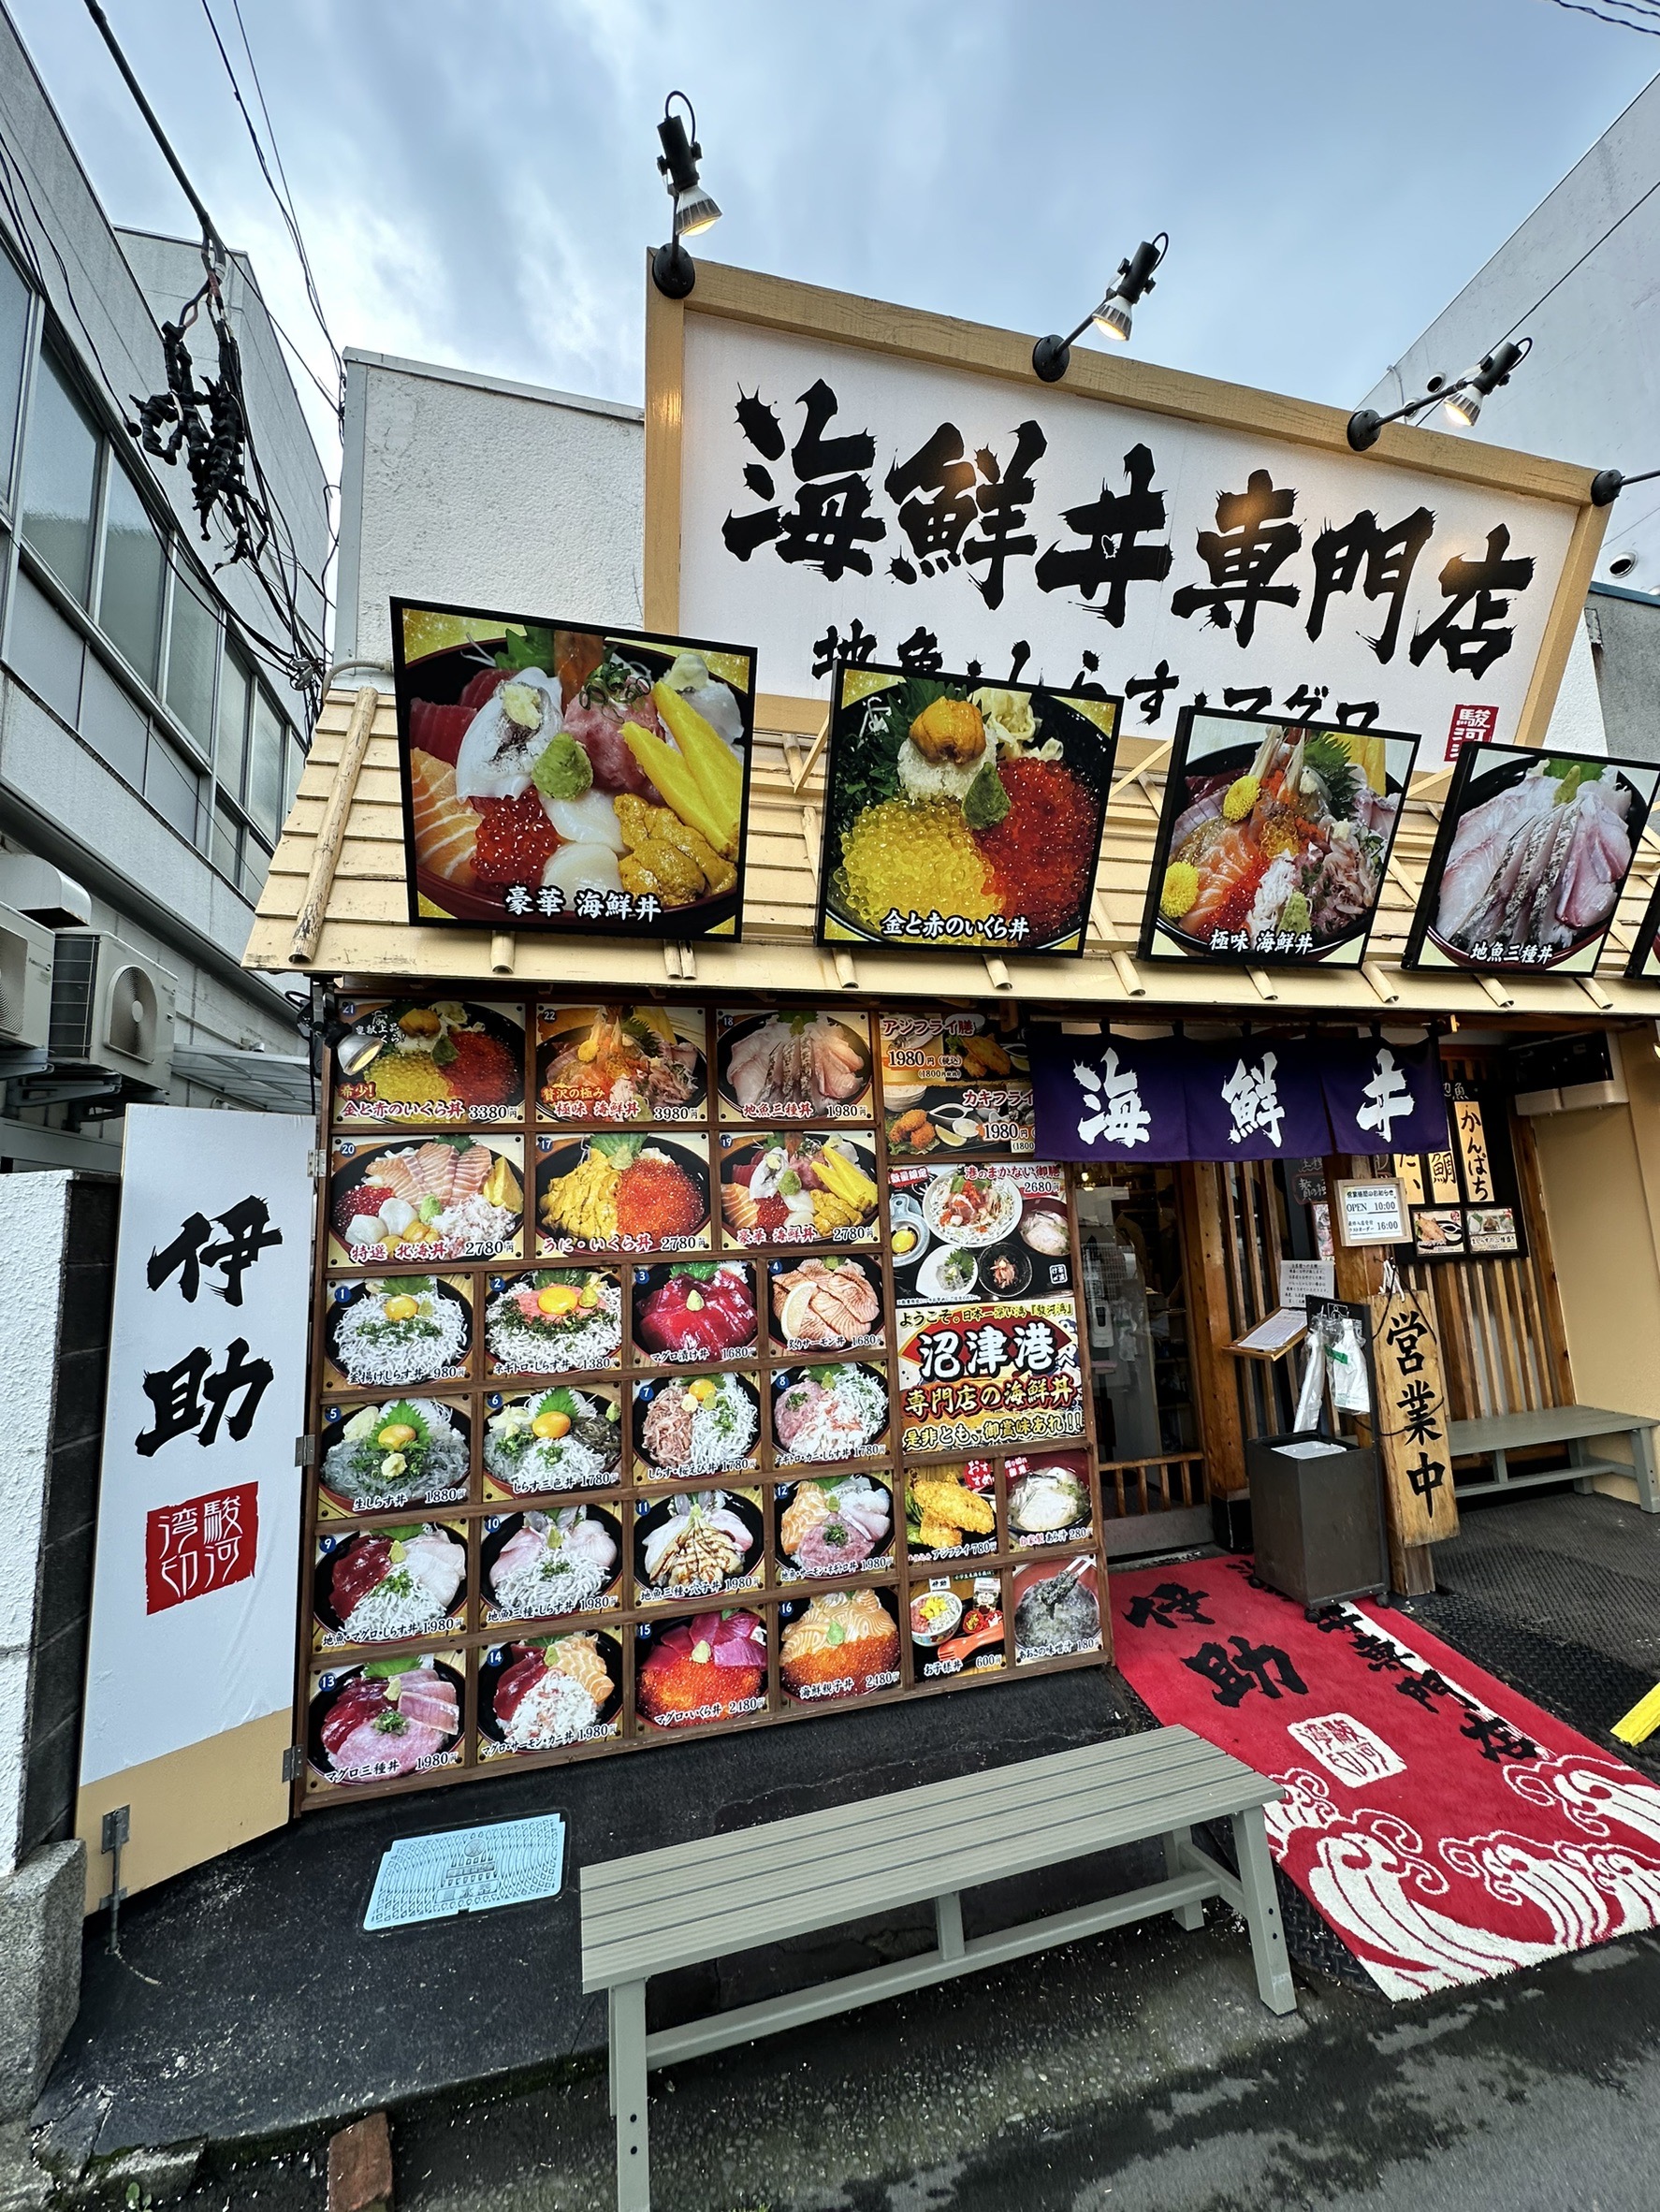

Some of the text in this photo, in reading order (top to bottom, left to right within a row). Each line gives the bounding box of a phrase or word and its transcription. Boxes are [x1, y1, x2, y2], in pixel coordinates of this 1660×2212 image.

[721, 377, 1536, 680] 海鮮丼専門店
[504, 885, 663, 923] 豪華 海鮮丼
[881, 910, 1030, 941] 金と赤のいくら丼
[1209, 928, 1314, 954] 極味 海鮮丼
[1470, 941, 1553, 965] 地魚三種丼
[342, 1003, 354, 1014] 21
[544, 1011, 556, 1021] 22
[723, 1016, 734, 1026] 18
[882, 1018, 975, 1036] アジフライ膳
[340, 1084, 373, 1099] 希少!
[542, 1087, 605, 1100] 贅沢の極み
[342, 1100, 463, 1118] 金と赤のいくら丼
[555, 1101, 588, 1118] 極味
[593, 1100, 640, 1118] 海鮮丼
[743, 1102, 813, 1118] 地魚三種丼
[342, 1144, 355, 1155] 20
[540, 1140, 551, 1150] 17
[721, 1138, 732, 1147] 19
[1461, 1110, 1488, 1201] かんぱち
[965, 1165, 1060, 1180] 港のまかない御膳
[1347, 1201, 1395, 1212] OPEN 10:00
[1377, 1220, 1398, 1230] 16:00
[737, 1228, 766, 1244] 豪華
[772, 1226, 817, 1244] 海鮮丼
[543, 1236, 652, 1254] うに・いくら丼
[350, 1245, 386, 1261] 特選
[773, 1261, 779, 1271] 4
[493, 1278, 502, 1288] 2
[639, 1272, 646, 1281] 3
[339, 1289, 346, 1300] 1
[135, 1195, 283, 1458] 伊助
[917, 1320, 1076, 1380] 沼津港へ
[495, 1360, 571, 1374] ネギトロ・しらす丼
[349, 1369, 424, 1384] 釜揚げしらす丼
[779, 1376, 786, 1386] 8
[491, 1394, 499, 1405] 6
[643, 1388, 650, 1398] 7
[904, 1375, 1075, 1419] 専門店の海鮮丼
[330, 1407, 338, 1419] 5
[1386, 1311, 1446, 1518] 営業中
[775, 1448, 852, 1465] ネギトロ・カニ・しらす丼
[648, 1463, 717, 1479] しらす・桜えび丼
[513, 1477, 575, 1493] しらす三色丼
[777, 1486, 788, 1496] 12
[354, 1494, 408, 1510] 生しらす丼
[638, 1503, 648, 1513] 11
[487, 1519, 500, 1530] 10
[324, 1538, 331, 1550] 9
[780, 1562, 857, 1581] 地魚・サーモン・ネギトロ丼
[641, 1580, 721, 1601] 地魚三種・穴子丼
[487, 1601, 575, 1623] 地魚三種・しらす丼
[781, 1602, 793, 1613] 16
[323, 1624, 418, 1646] 地魚・マグロ・しらす丼
[639, 1624, 651, 1636] 15
[488, 1652, 502, 1664] 14
[322, 1676, 335, 1688] 13
[654, 1706, 722, 1725] マグロ・いくら丼
[482, 1732, 574, 1757] マグロ・サーモン・カニ丼
[325, 1760, 400, 1783] マグロ三種丼
